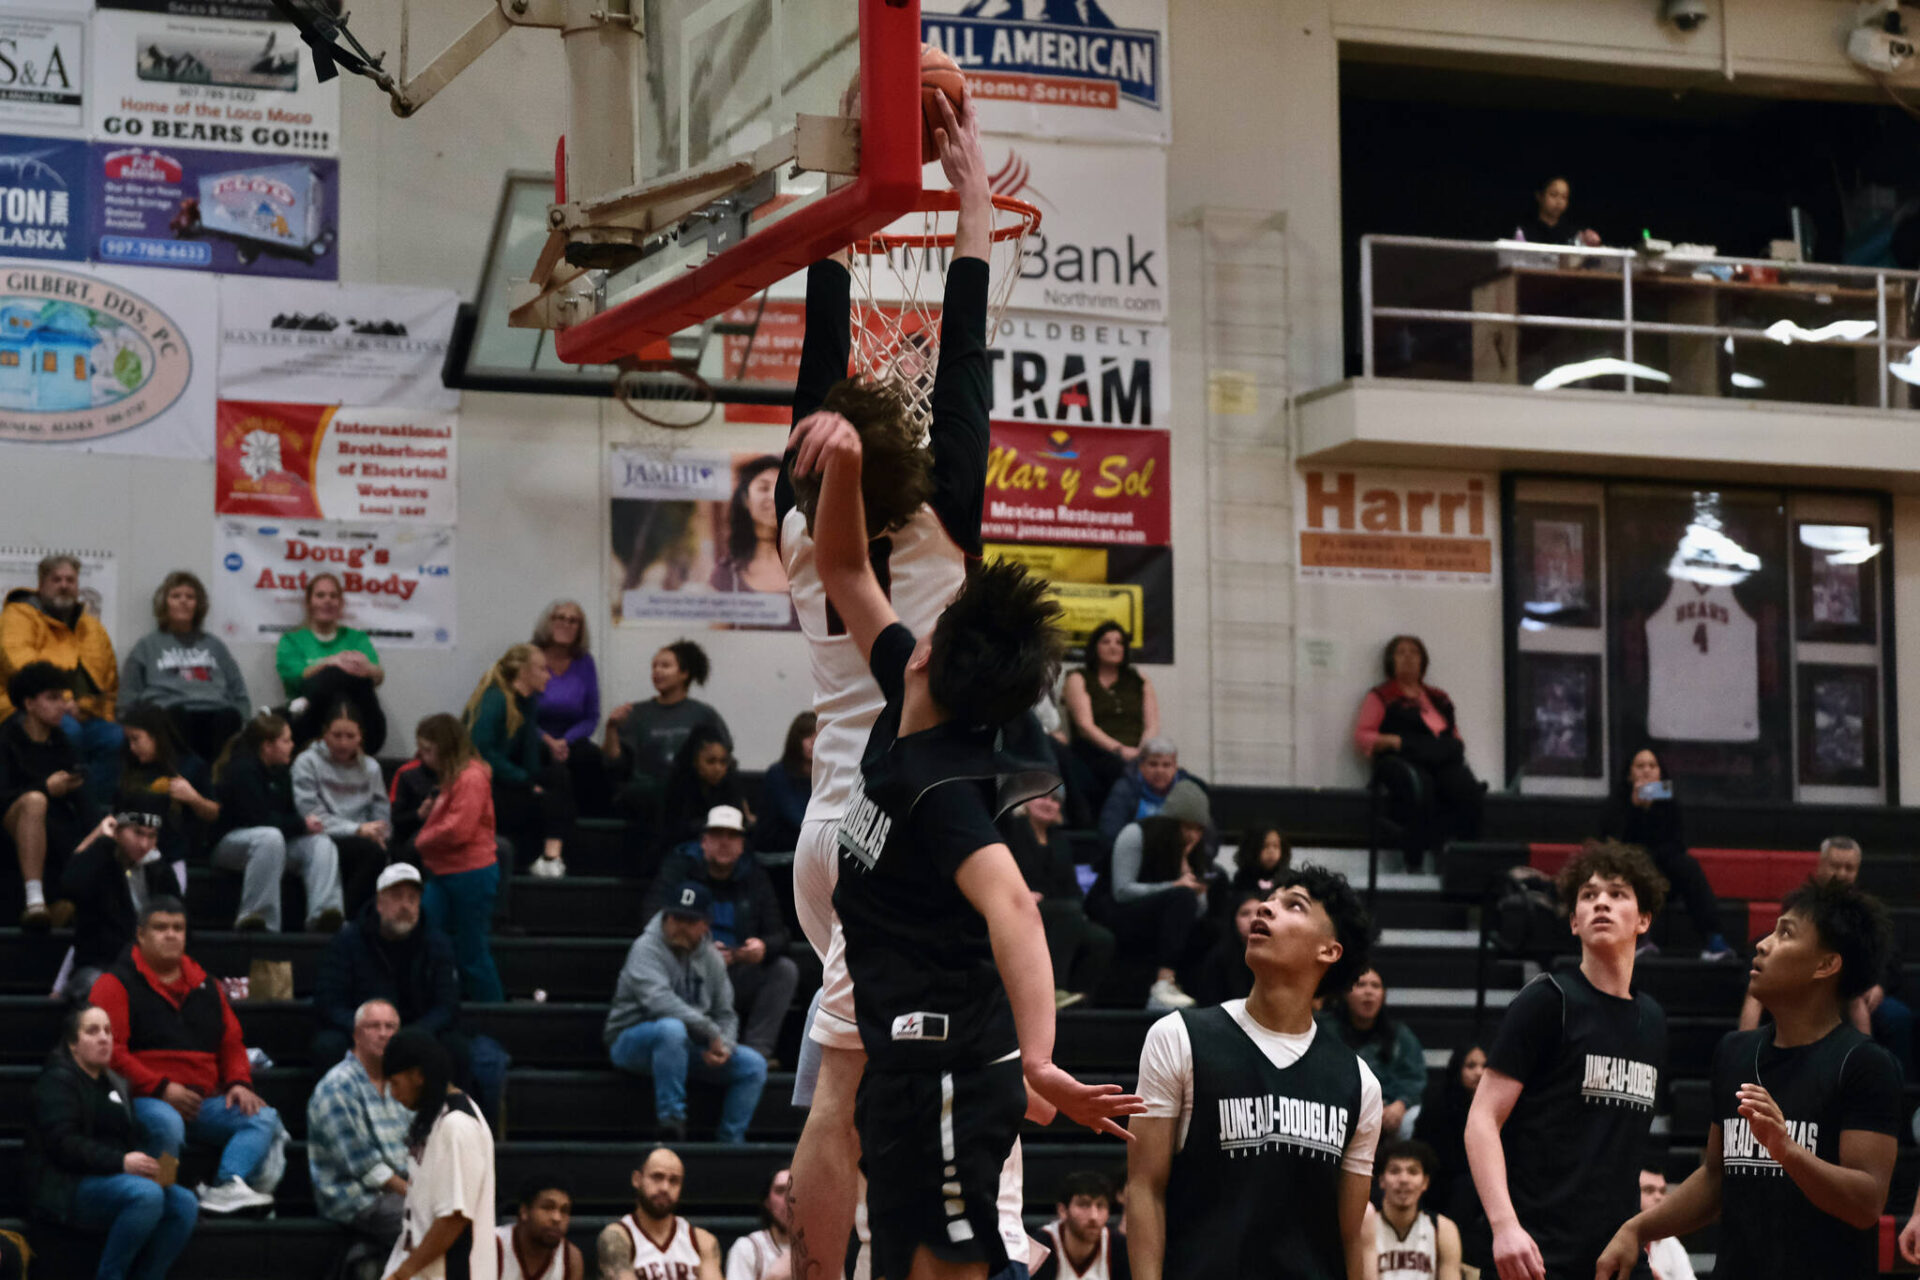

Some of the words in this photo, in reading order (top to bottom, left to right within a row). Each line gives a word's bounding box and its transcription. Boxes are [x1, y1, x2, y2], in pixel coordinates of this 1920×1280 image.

[926, 25, 984, 65] ALL
[991, 29, 1154, 85] AMERICAN
[972, 78, 1028, 96] Home
[1033, 82, 1111, 104] Service
[121, 97, 168, 113] Home
[174, 100, 191, 114] of
[195, 102, 221, 118] the
[226, 104, 262, 121] Loco
[267, 108, 312, 124] Moco
[104, 117, 143, 135] GO
[152, 119, 244, 143] BEARS
[251, 127, 329, 149] GO!!!!
[1018, 231, 1158, 288] Bank
[1044, 287, 1161, 312] Northrim.com
[7, 272, 94, 303] GILBERT,
[152, 326, 178, 358] PC
[334, 421, 452, 439] International
[338, 441, 448, 459] Brotherhood
[338, 463, 357, 477] of
[362, 463, 447, 480] Electrical
[985, 445, 1048, 491] Mar
[1060, 467, 1082, 506] y
[1093, 454, 1156, 498] Sol
[357, 484, 429, 499] Workers
[1306, 471, 1485, 535] Harri
[990, 501, 1055, 521] Mexican
[1057, 505, 1134, 526] Restaurant
[285, 538, 390, 568] Doug's
[255, 567, 309, 590] Aut
[342, 571, 419, 600] Body
[1676, 601, 1729, 625] BEARS
[1692, 622, 1709, 655] 4
[680, 888, 696, 906] D
[1218, 1093, 1348, 1149] JUNEAU-DOUGLAS
